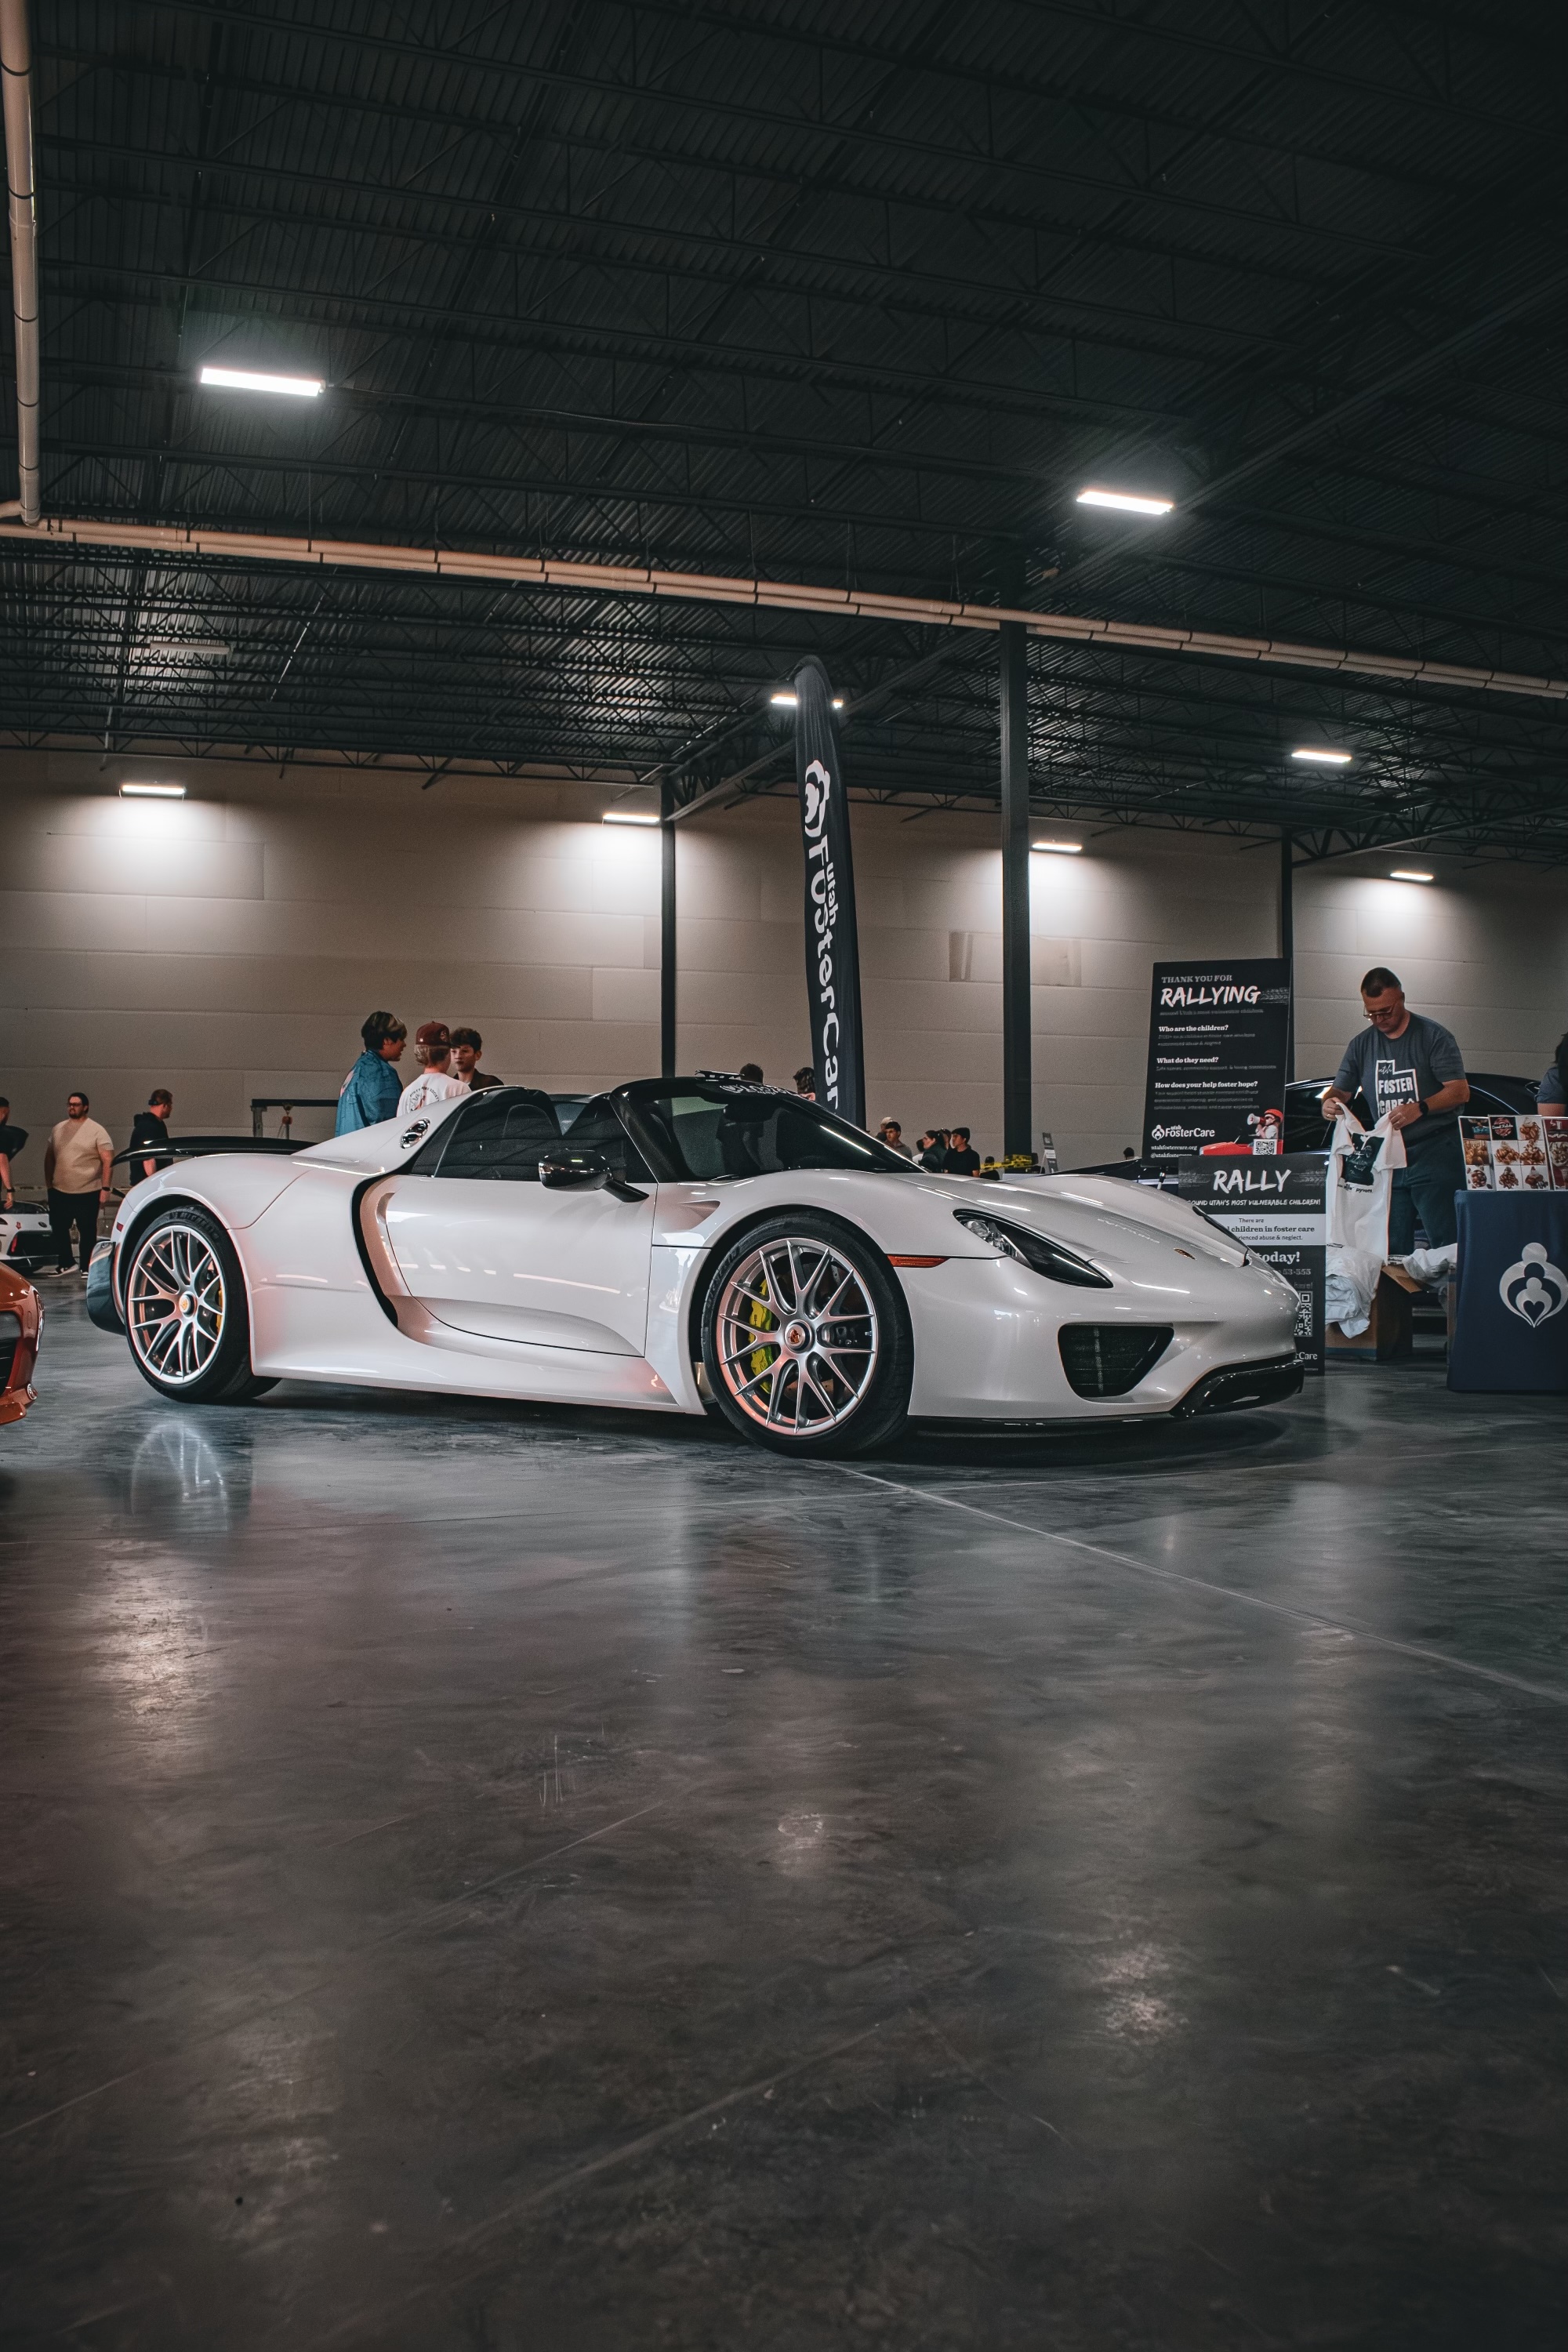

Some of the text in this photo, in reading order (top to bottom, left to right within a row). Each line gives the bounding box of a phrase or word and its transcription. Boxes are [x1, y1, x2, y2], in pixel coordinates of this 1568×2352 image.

[826, 862, 839, 926] utah
[808, 834, 840, 1110] FosterCar
[1160, 985, 1261, 1007] RALLYING
[1378, 1076, 1414, 1094] FOSTER
[1165, 1127, 1215, 1138] FosterCare
[1213, 1169, 1292, 1194] RALLY
[1295, 1352, 1318, 1360] rCare
